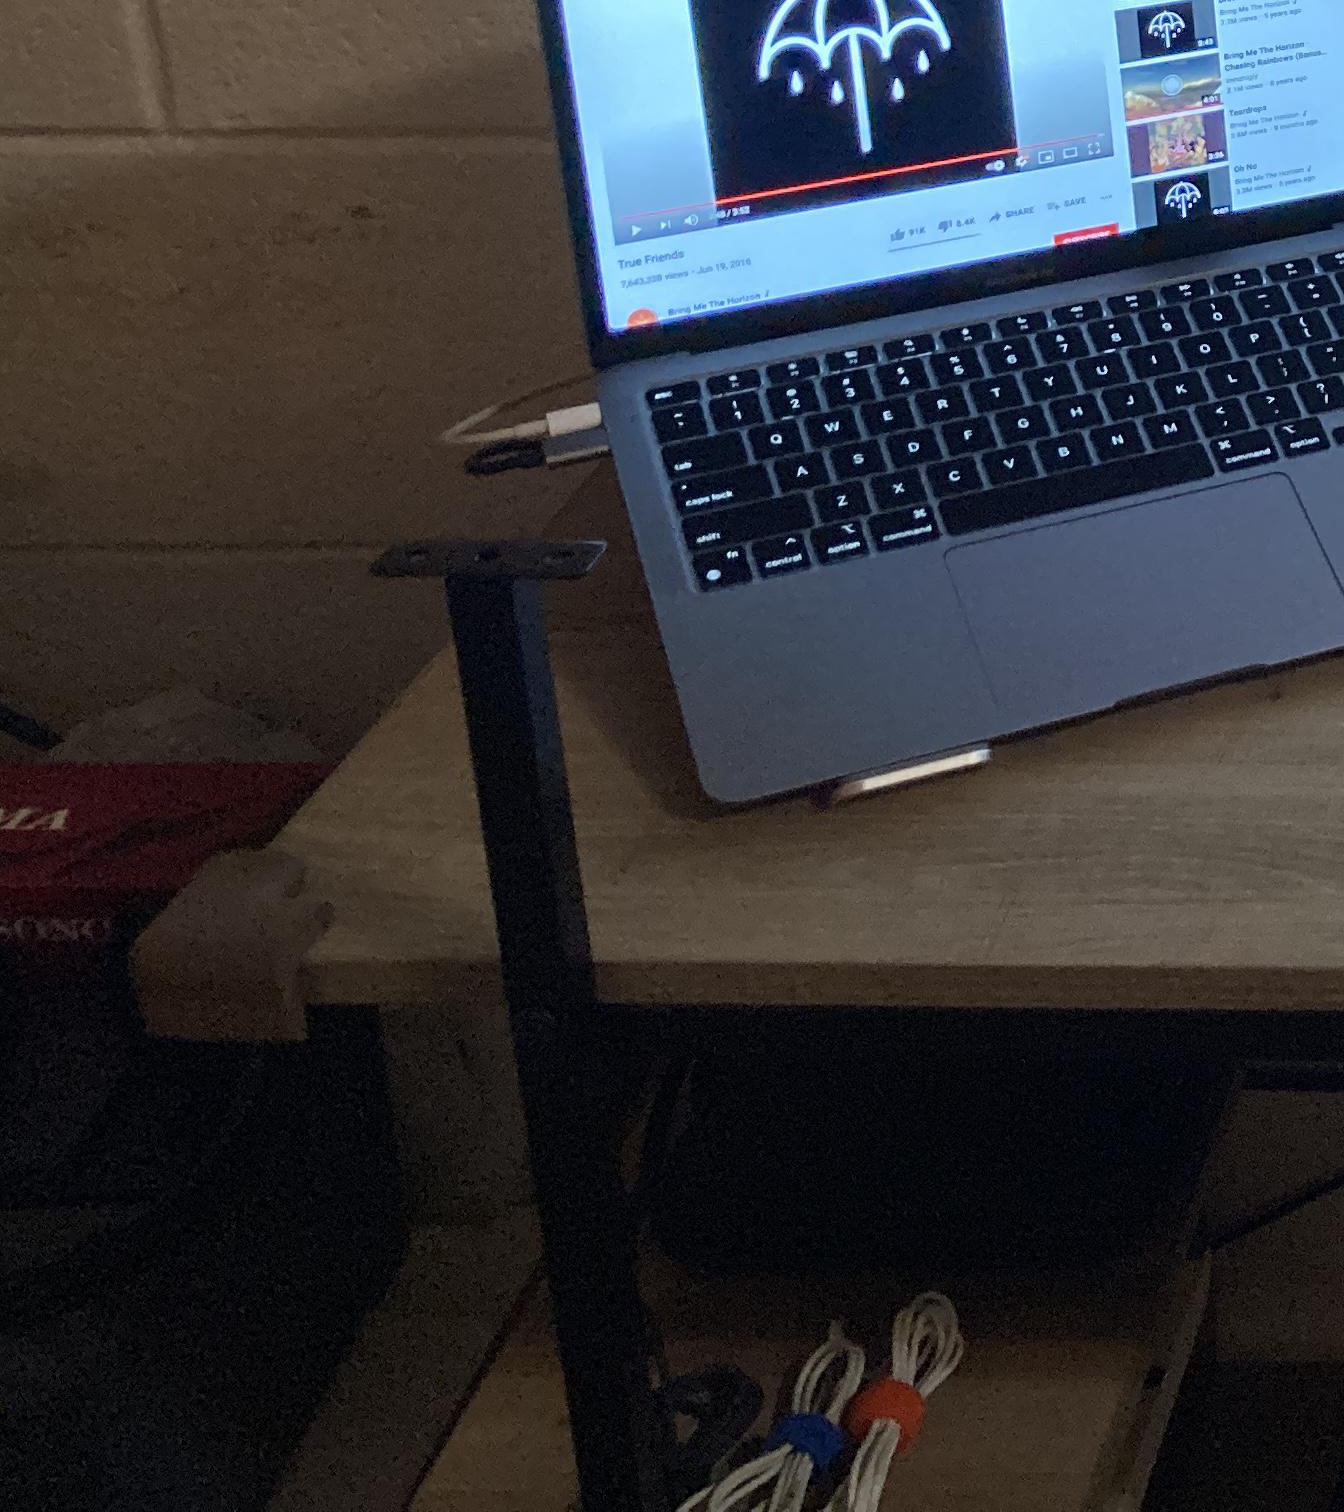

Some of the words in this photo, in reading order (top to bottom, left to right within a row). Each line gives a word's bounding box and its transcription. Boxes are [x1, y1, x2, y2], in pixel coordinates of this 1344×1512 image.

[1229, 104, 1267, 117] Teardrops
[1005, 206, 1035, 219] SHARE
[618, 254, 645, 270] True
[647, 248, 685, 266] Friends
[1226, 447, 1271, 464] command
[882, 525, 932, 542] command
[765, 553, 803, 568] control
